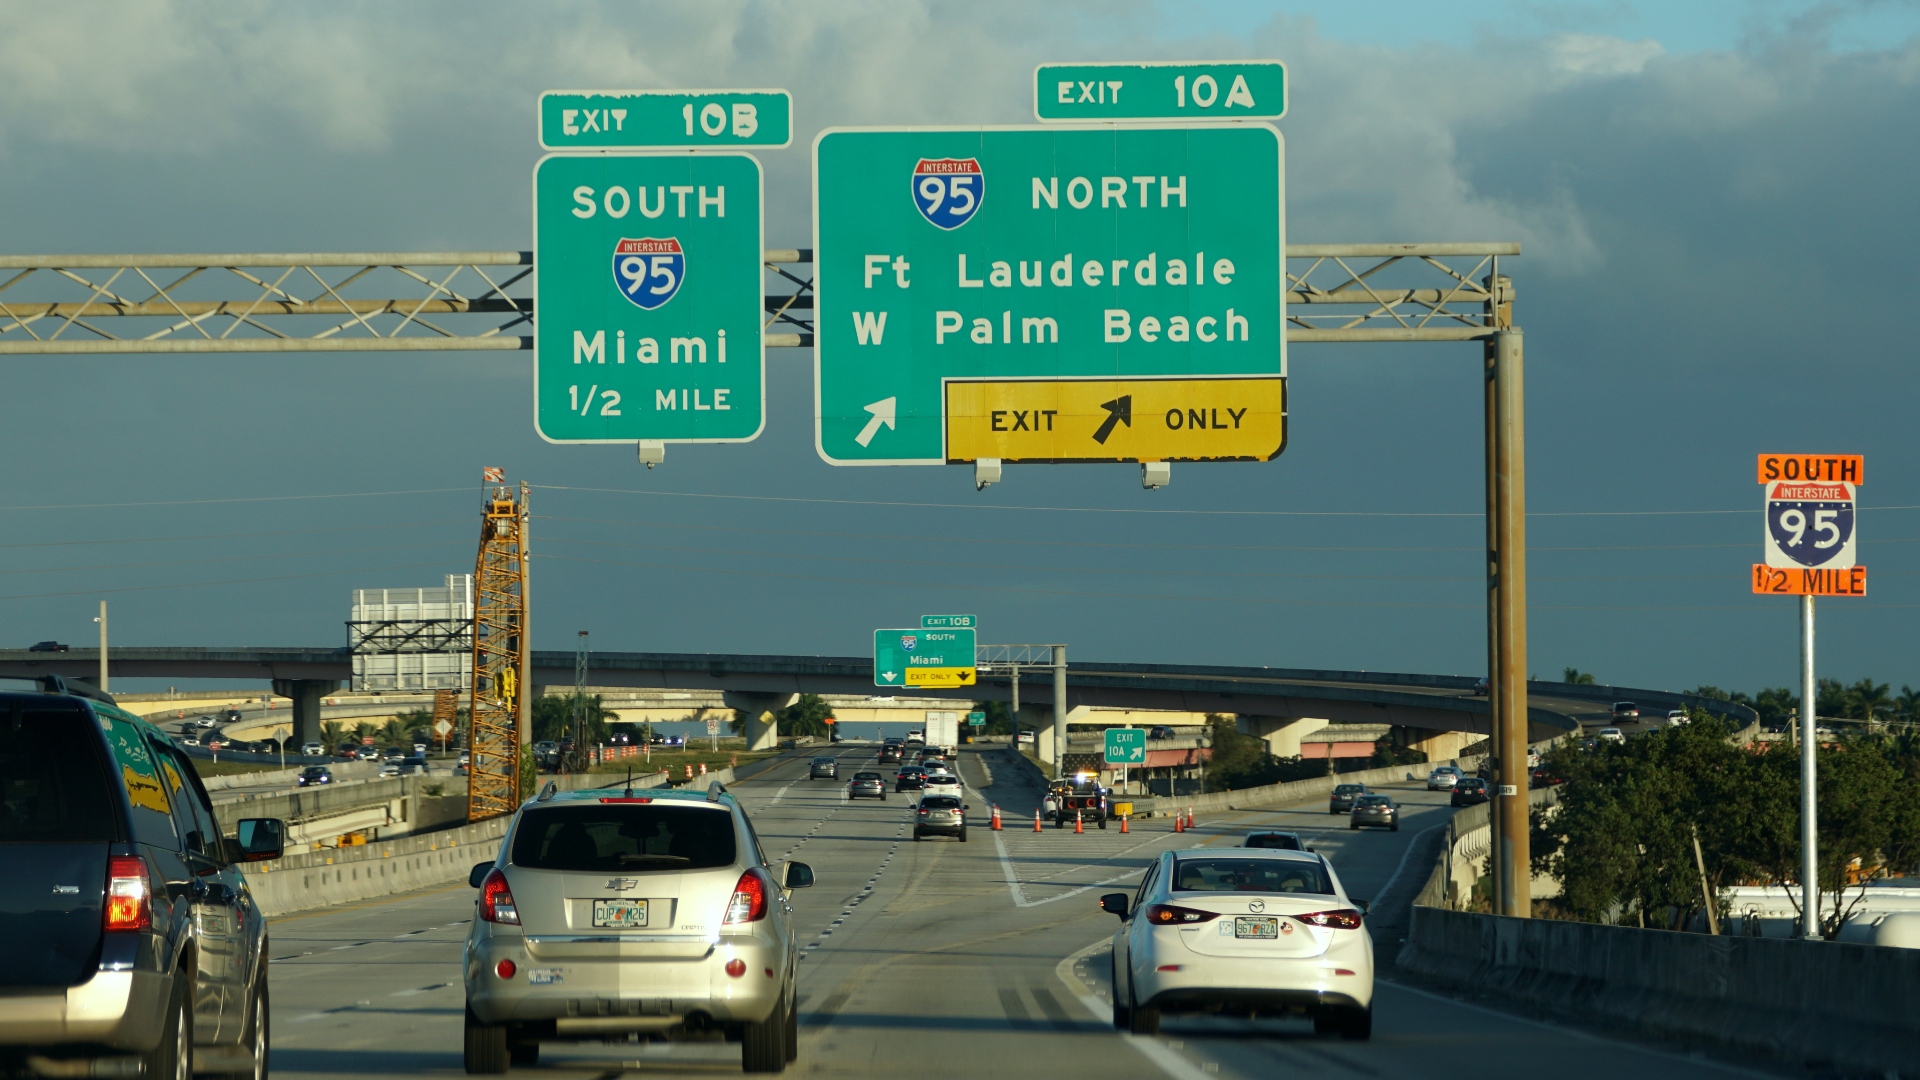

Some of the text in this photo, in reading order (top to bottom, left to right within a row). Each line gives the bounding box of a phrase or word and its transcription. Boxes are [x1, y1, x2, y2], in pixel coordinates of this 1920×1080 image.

[1058, 75, 1255, 108] EXIT 10A
[563, 103, 758, 138] EXIT 10B
[923, 163, 973, 173] INTERSTATE
[572, 186, 725, 218] SOUTH
[919, 177, 975, 215] 95
[1032, 176, 1187, 209] NORTH
[623, 242, 673, 253] INTERSTATE
[620, 257, 676, 295] 95
[864, 252, 1235, 288] Ft Lauderdale
[852, 308, 1249, 345] W Palm Beach
[573, 330, 727, 364] Miami
[569, 385, 731, 416] 1/2 MILE
[991, 408, 1248, 432] EXIT ONLY
[1765, 458, 1856, 481] SOUTH
[1781, 487, 1841, 499] INTERSTATE
[1779, 509, 1840, 549] 95
[1756, 565, 1864, 594] 1/2 MILE
[949, 617, 970, 626] 10B
[902, 639, 915, 649] 95
[926, 633, 956, 641] SOUTH
[910, 655, 944, 665] Miami
[1116, 733, 1134, 743] EXIT
[1109, 745, 1125, 757] 10A
[596, 907, 645, 921] CUP M26
[1237, 923, 1252, 934] 967
